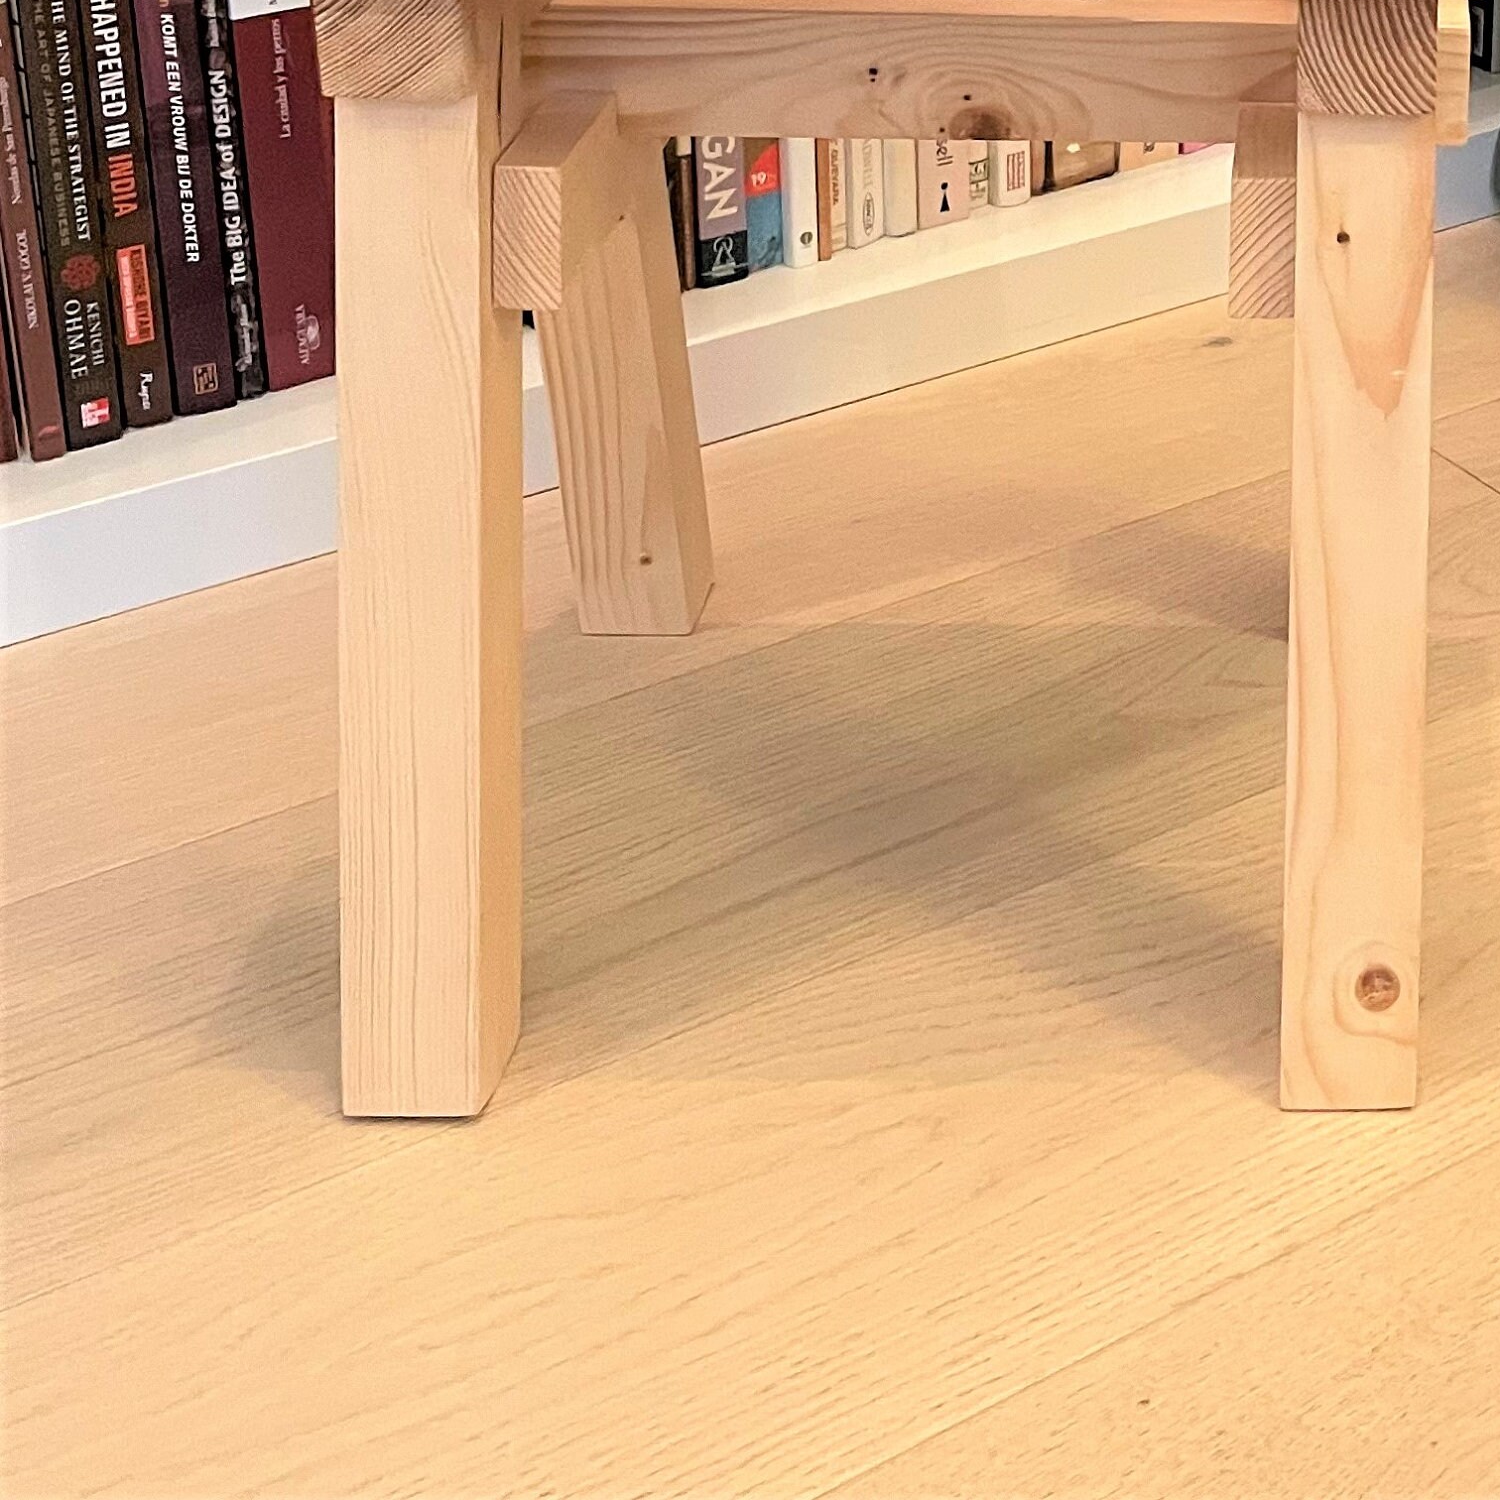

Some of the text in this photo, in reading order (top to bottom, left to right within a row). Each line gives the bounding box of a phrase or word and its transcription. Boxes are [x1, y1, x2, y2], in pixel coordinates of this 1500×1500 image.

[159, 14, 179, 51] KOMT
[55, 31, 71, 77] MIND
[61, 81, 74, 100] OF
[166, 56, 182, 90] EEN
[64, 100, 78, 136] THE
[208, 69, 232, 134] DESIGN
[105, 123, 131, 148] IN
[168, 93, 188, 151] VROUW
[176, 155, 189, 175] BIJ
[217, 137, 234, 163] of
[936, 139, 953, 167] sell
[67, 137, 92, 242] STRATEGIST
[108, 153, 138, 218] INDIA
[179, 178, 191, 198] DE
[220, 167, 240, 213] IDEA
[16, 228, 31, 270] GOGOL
[181, 202, 200, 263] DOKTER
[226, 214, 243, 249] BIG
[230, 250, 247, 286] The
[64, 300, 88, 380] OHMAE
[85, 301, 104, 367] KENICHI
